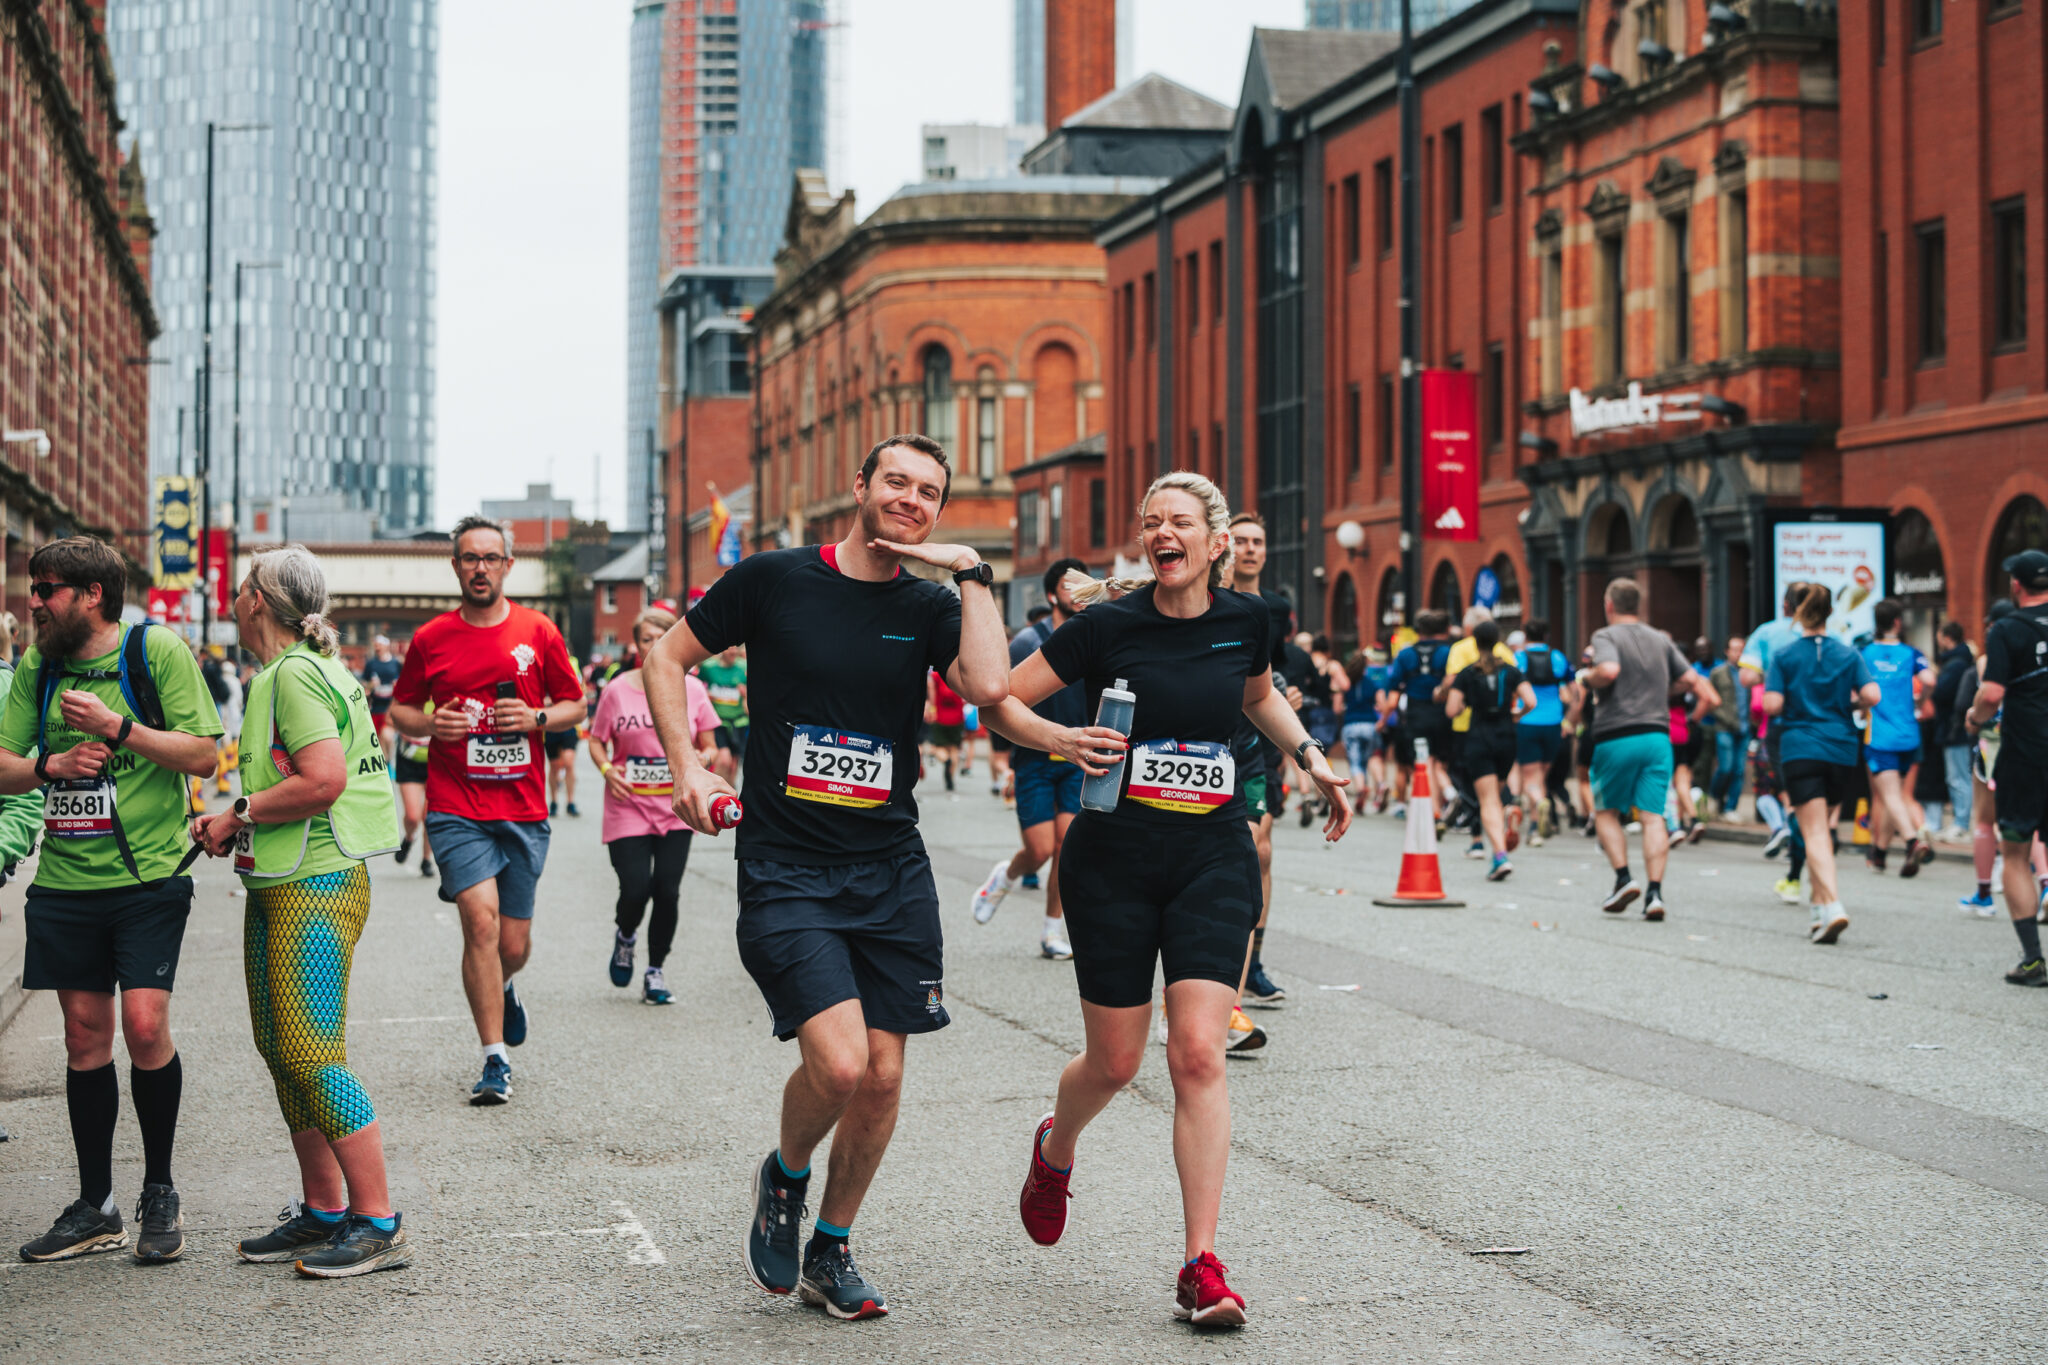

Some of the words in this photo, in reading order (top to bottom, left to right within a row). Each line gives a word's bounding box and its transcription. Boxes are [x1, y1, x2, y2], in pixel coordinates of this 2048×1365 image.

[616, 714, 655, 732] PAU
[474, 747, 525, 764] 36935
[801, 749, 882, 783] 32937
[1142, 759, 1224, 789] 32938
[827, 783, 854, 795] SIMON
[1160, 789, 1201, 802] GEORGINA
[50, 796, 105, 816] 35681
[73, 820, 94, 828] SIMON
